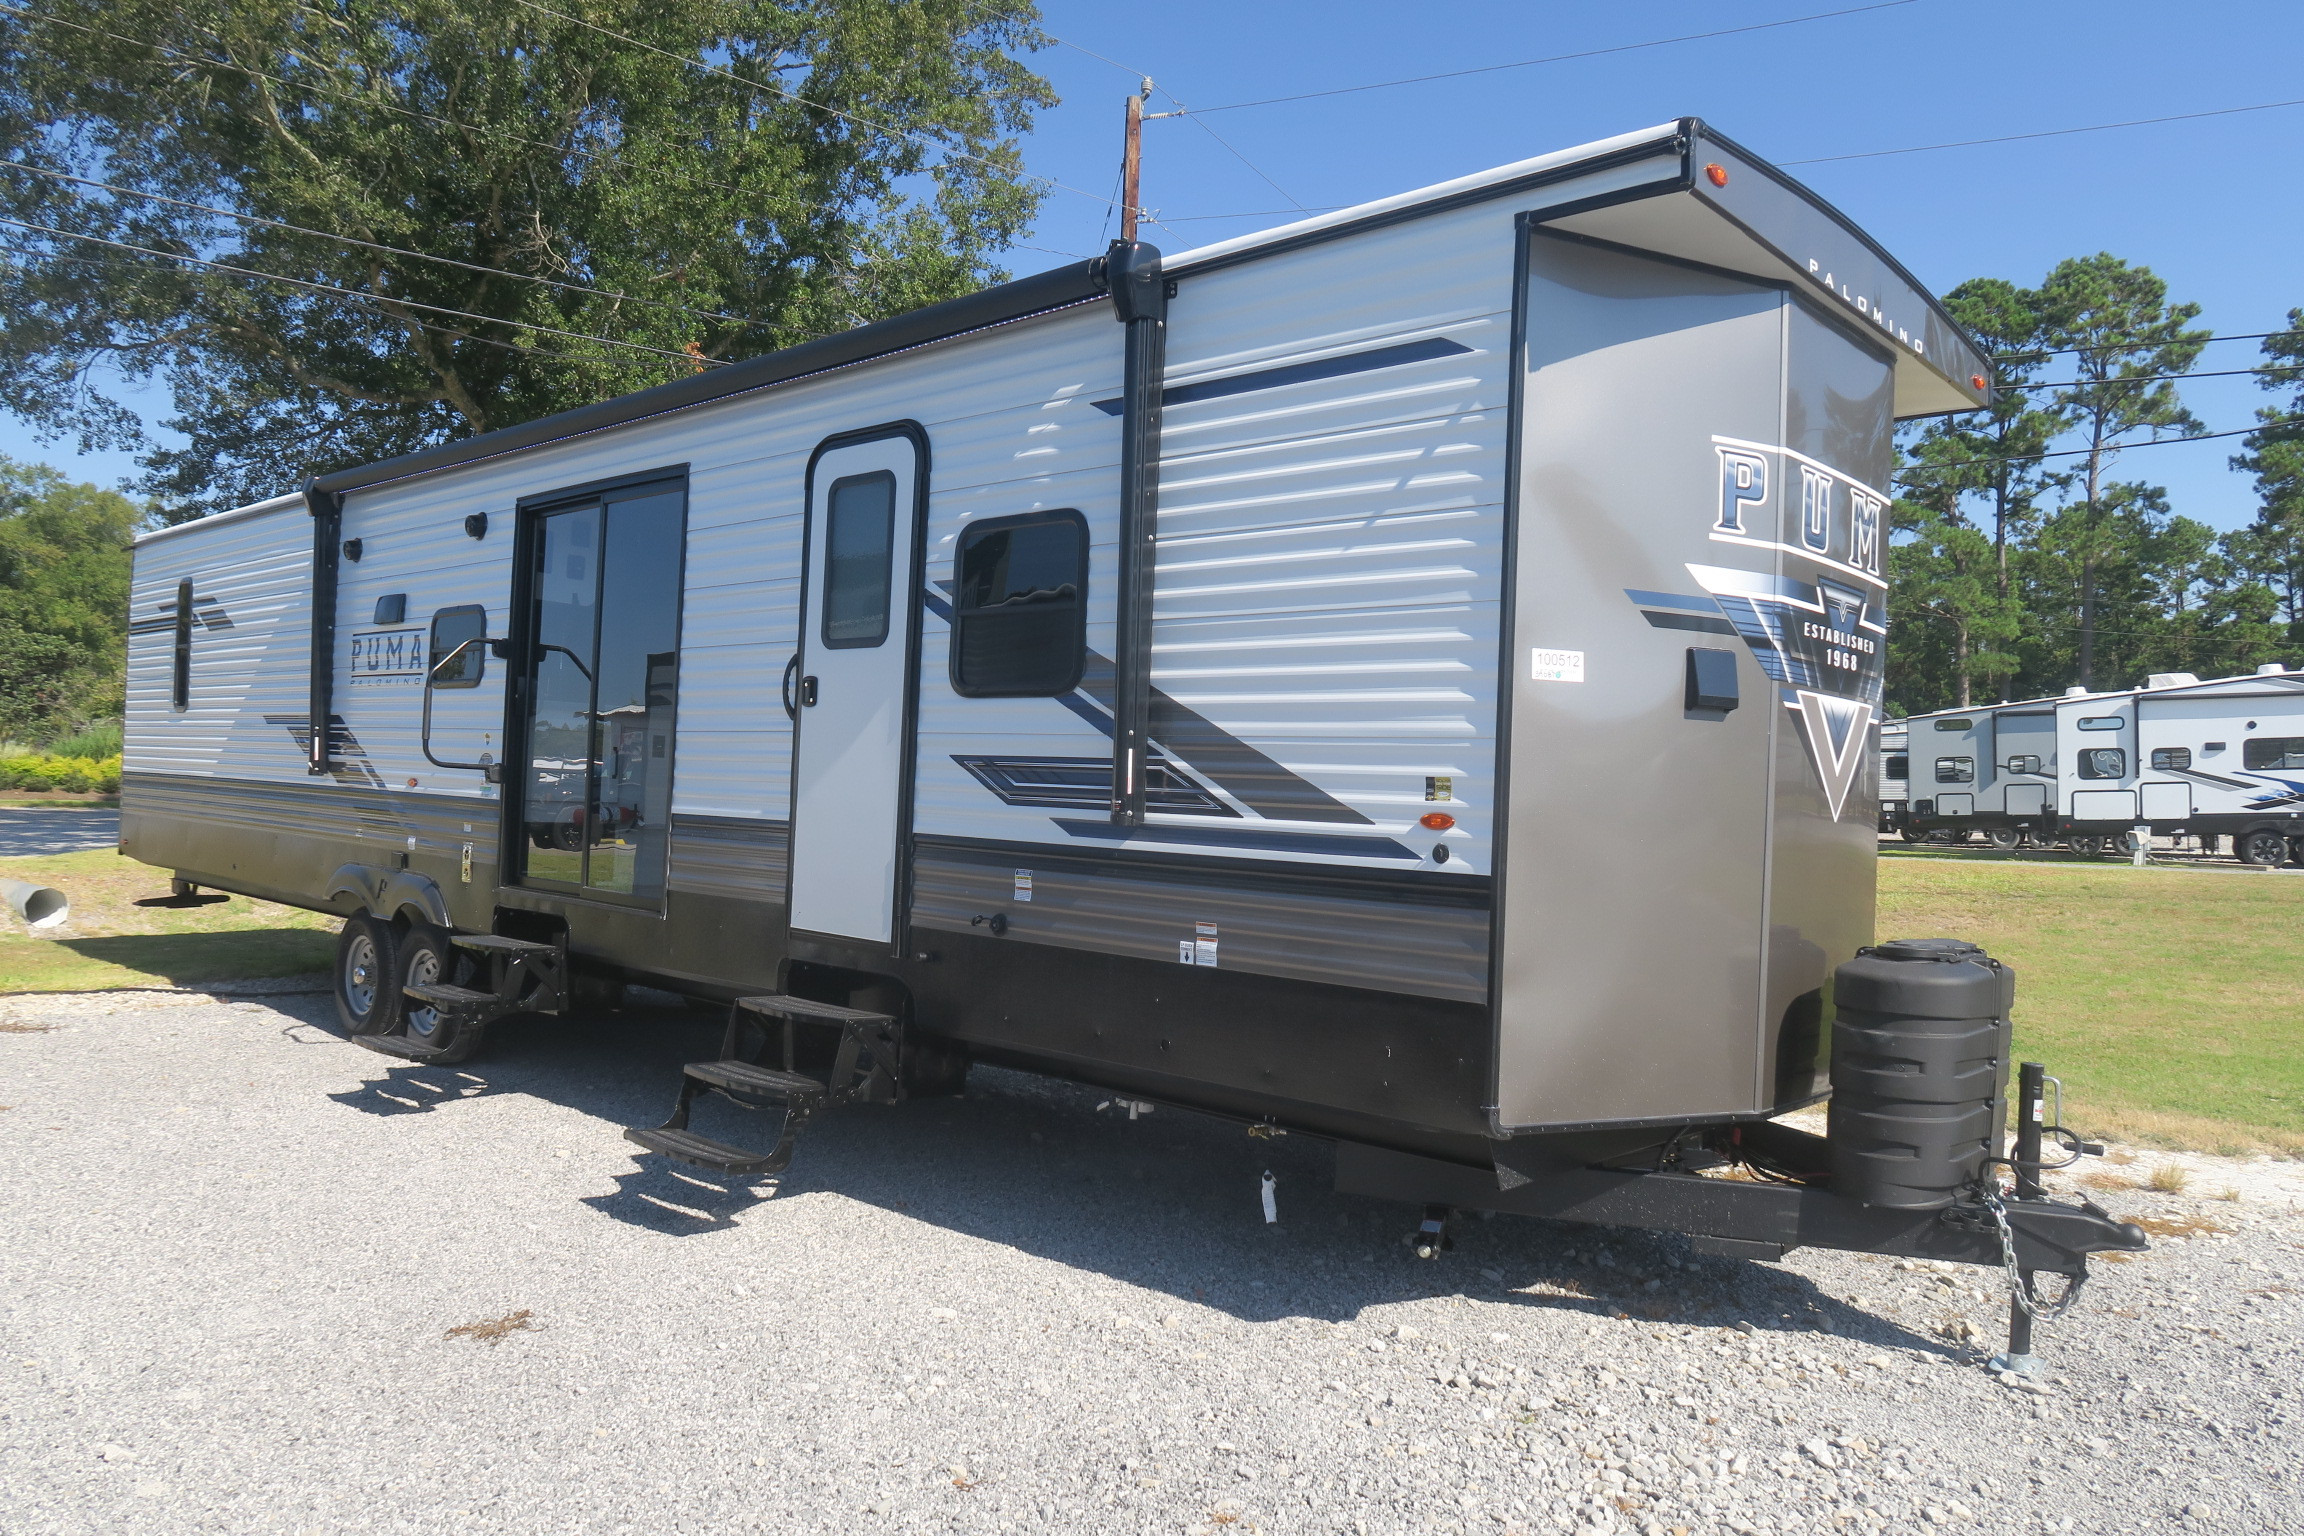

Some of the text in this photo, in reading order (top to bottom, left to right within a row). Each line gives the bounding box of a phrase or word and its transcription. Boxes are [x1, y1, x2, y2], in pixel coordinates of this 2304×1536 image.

[1809, 258, 1923, 354] PALOMINO
[351, 634, 422, 672] PUMA
[1803, 621, 1875, 655] ESTABLISHED
[1537, 652, 1580, 668] 100512
[1826, 648, 1858, 672] 1968
